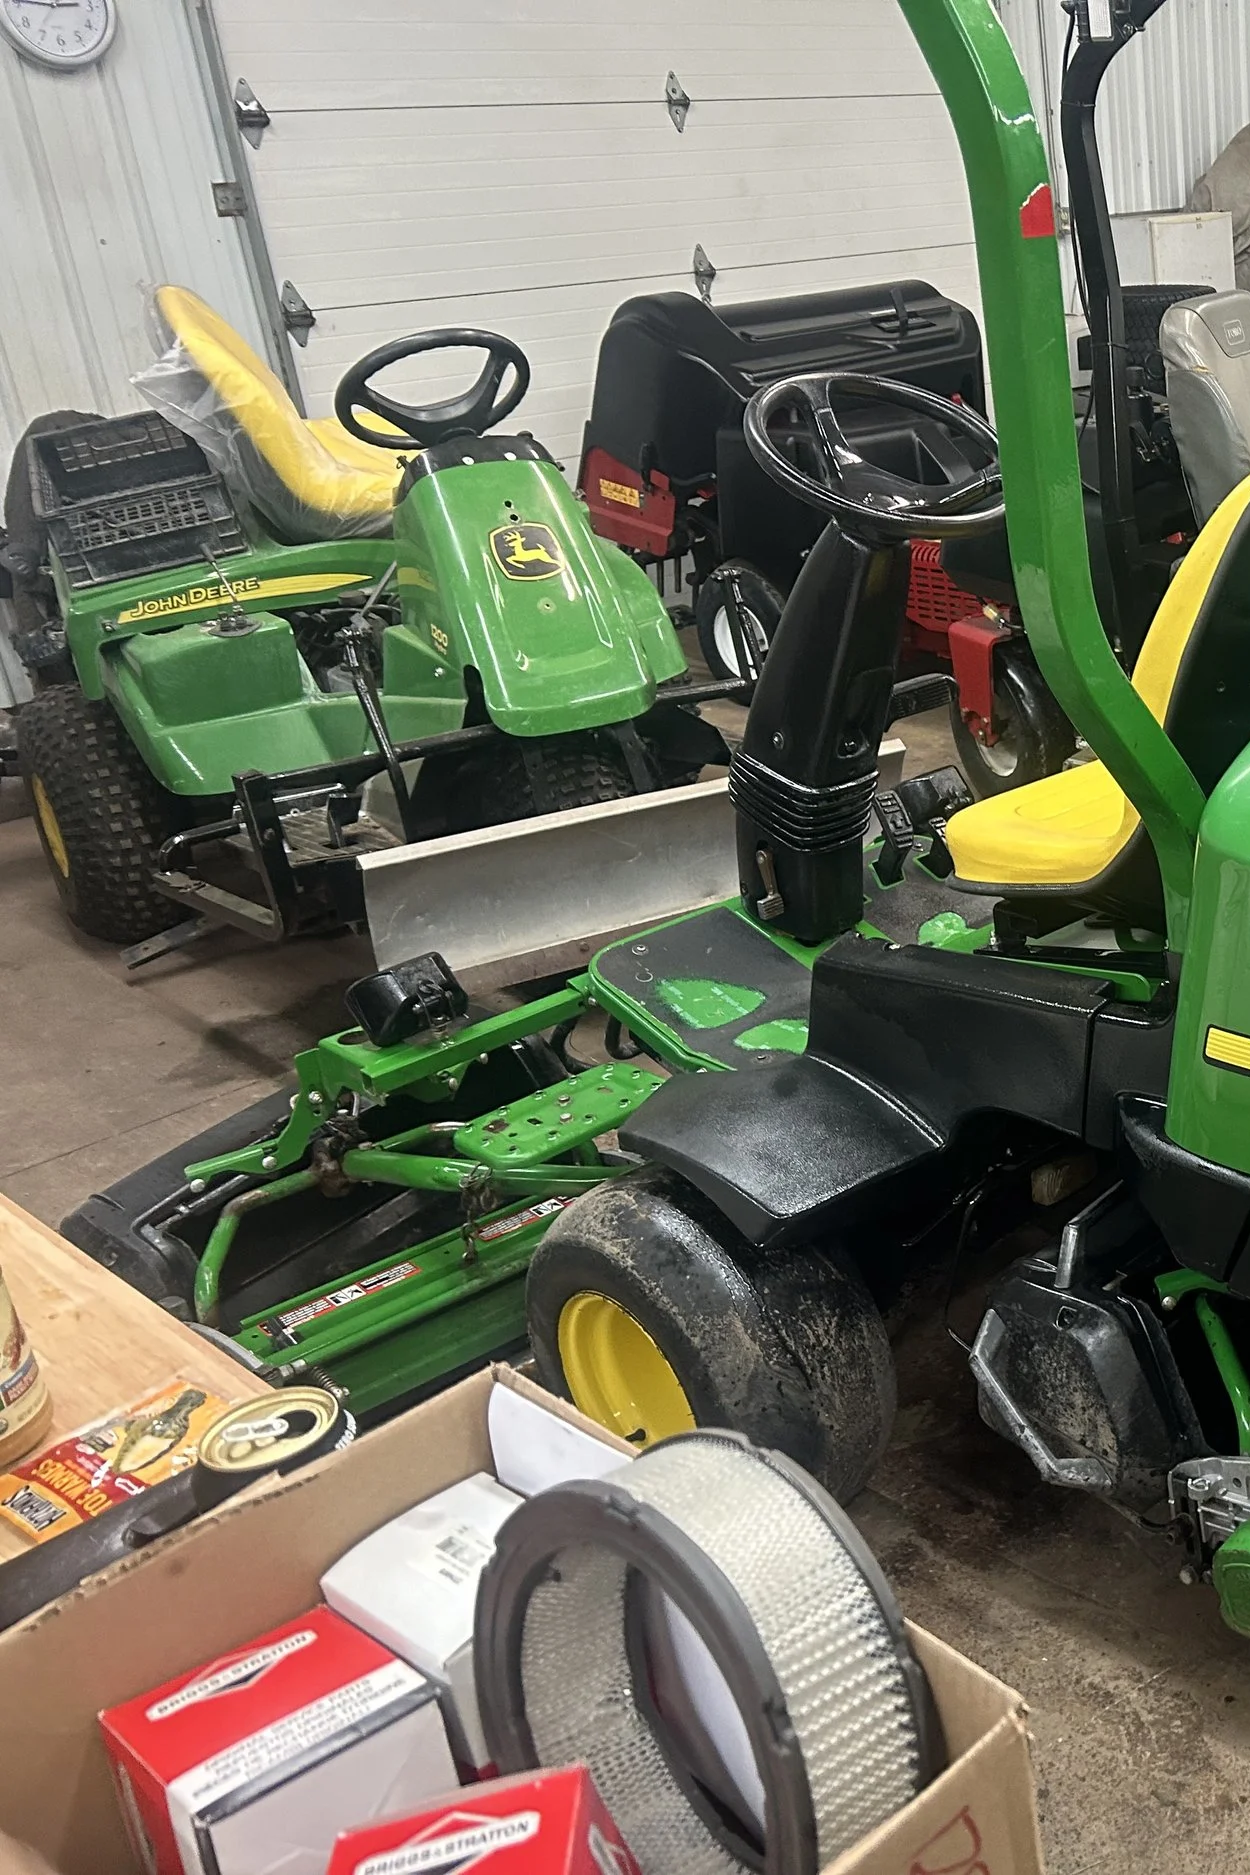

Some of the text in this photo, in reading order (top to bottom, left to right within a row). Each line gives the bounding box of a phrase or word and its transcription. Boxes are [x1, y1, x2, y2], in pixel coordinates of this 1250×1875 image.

[21, 15, 31, 29] 8
[84, 18, 93, 31] 4
[38, 28, 47, 41] 7
[56, 33, 66, 47] 6
[73, 29, 83, 44] 5
[130, 577, 260, 618] JOHN DEERE
[75, 1486, 113, 1518] TOE
[444, 1820, 530, 1853] STRATTON
